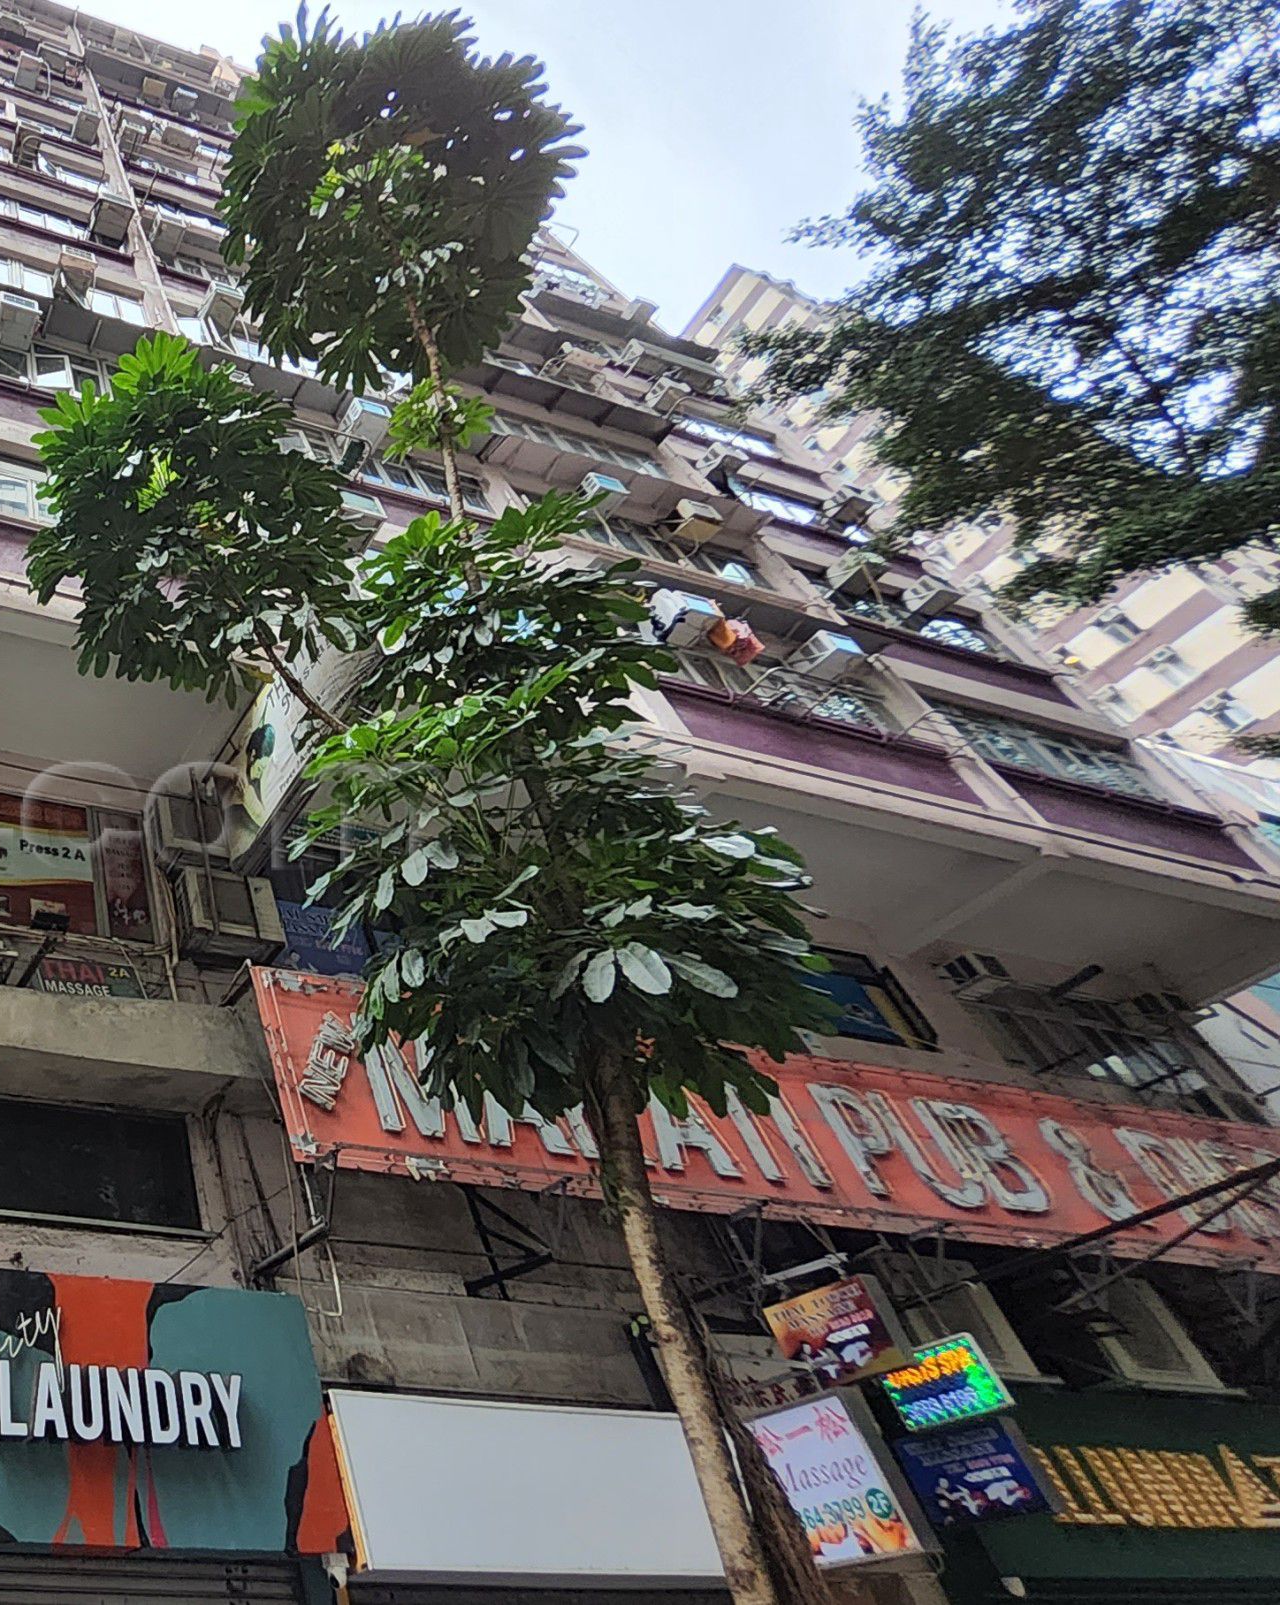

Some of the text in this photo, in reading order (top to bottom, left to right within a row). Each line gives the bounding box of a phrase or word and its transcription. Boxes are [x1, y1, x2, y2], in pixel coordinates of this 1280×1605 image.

[20, 839, 60, 857] Press
[42, 959, 131, 984] THAI 2A
[44, 979, 112, 998] MASSAGE
[806, 1080, 1052, 1213] PUB
[1038, 1115, 1144, 1224] &
